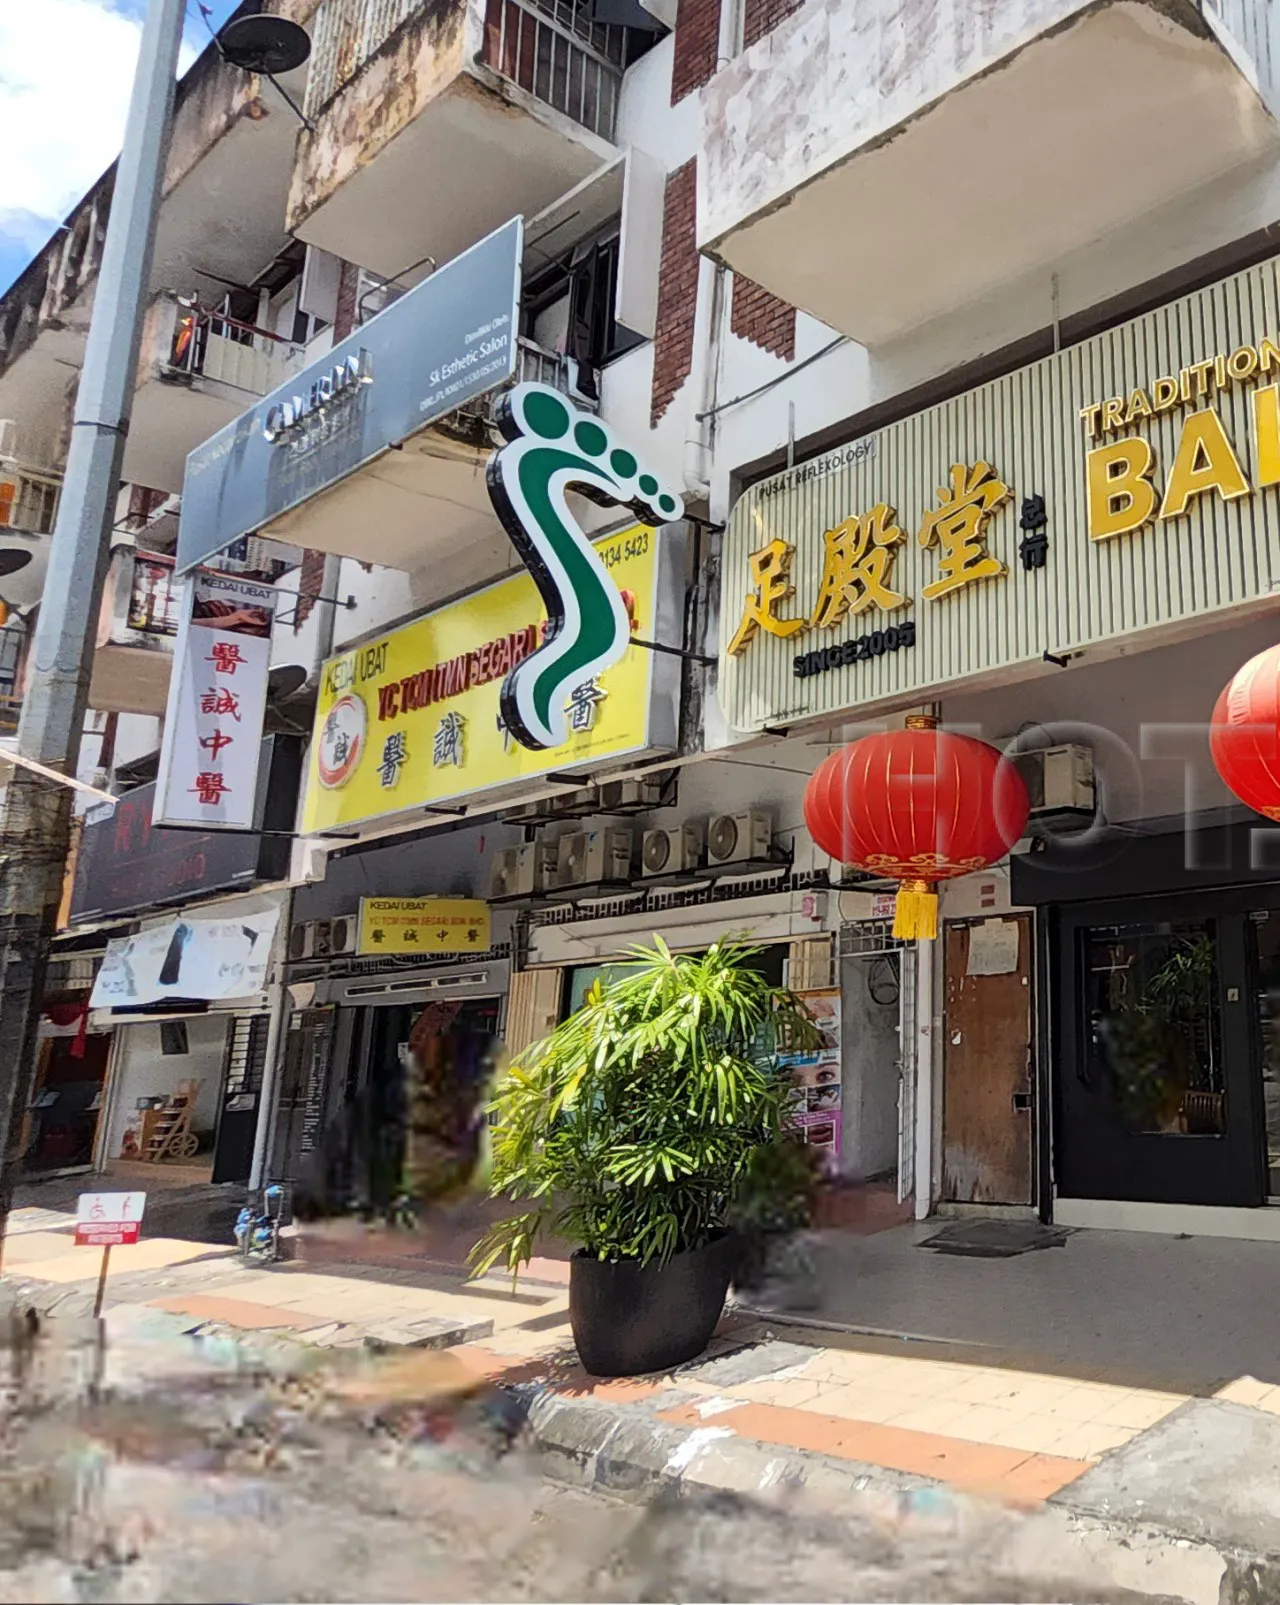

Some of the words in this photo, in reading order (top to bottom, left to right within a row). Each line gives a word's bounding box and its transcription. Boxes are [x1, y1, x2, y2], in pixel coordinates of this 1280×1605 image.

[479, 334, 508, 358] Salon
[760, 475, 792, 500] PUSAT
[796, 440, 872, 485] REFLEXOLOGY
[625, 533, 649, 561] 5423
[727, 460, 1015, 656] 足殿堂
[201, 577, 238, 593] KEDAI
[241, 585, 272, 599] UBAT
[325, 654, 357, 696] KEDAI
[361, 642, 390, 681] UBAT
[370, 901, 399, 911] KEDAI
[402, 902, 427, 911] UBAT
